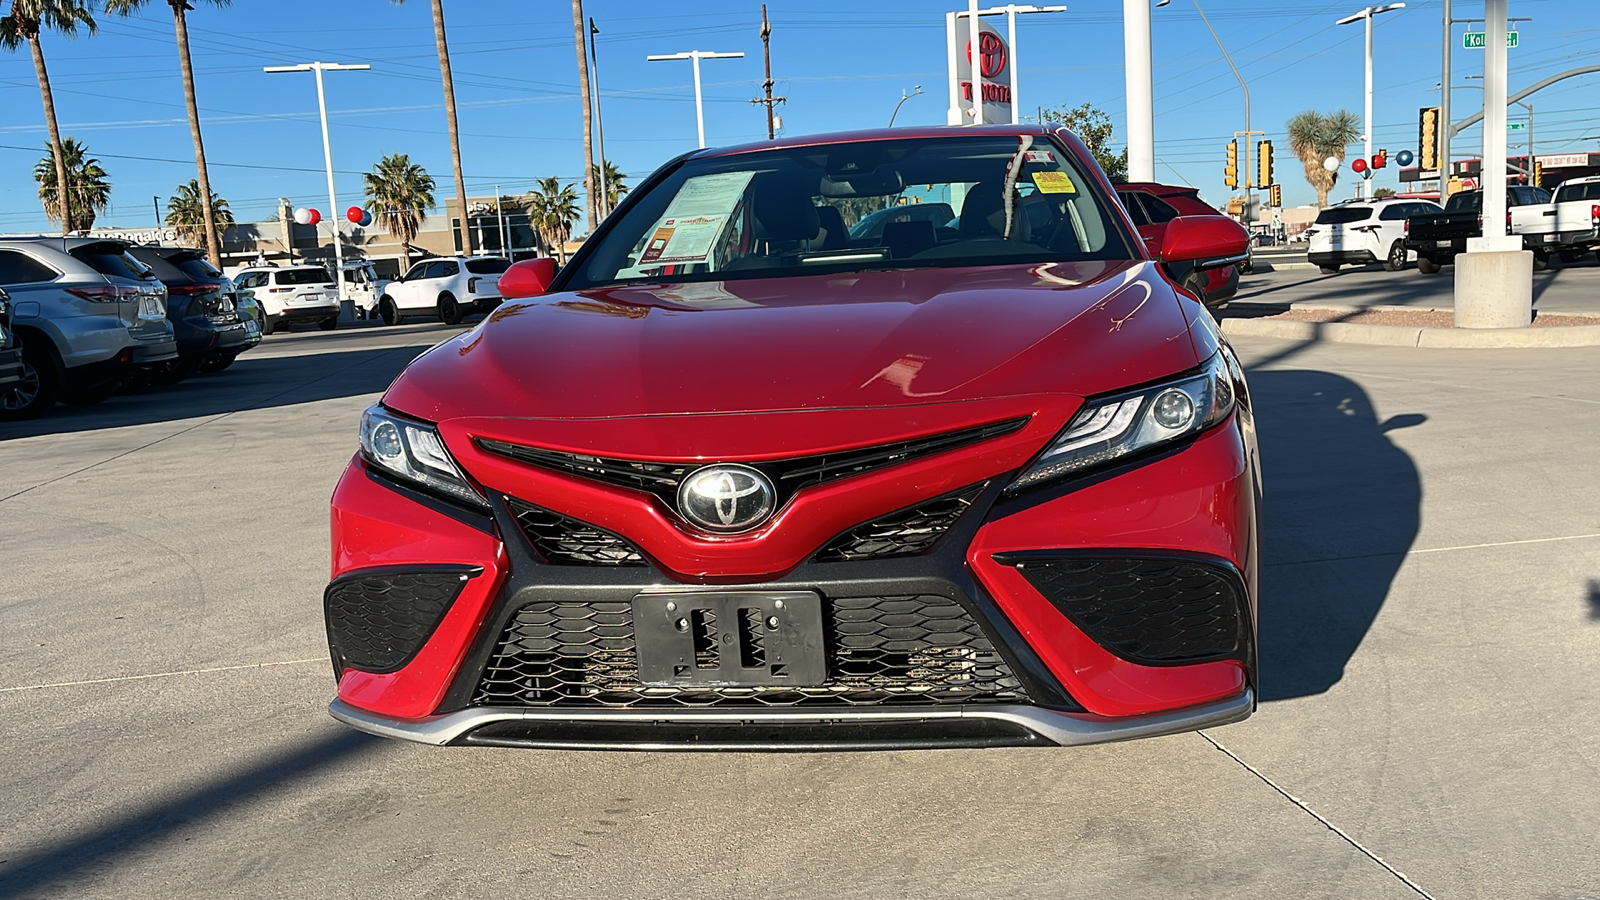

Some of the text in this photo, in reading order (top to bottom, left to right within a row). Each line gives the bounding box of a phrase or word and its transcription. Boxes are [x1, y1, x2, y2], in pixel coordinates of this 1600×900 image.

[1470, 34, 1486, 47] Kol
[960, 81, 1011, 103] TYOTA
[467, 201, 519, 213] playpace
